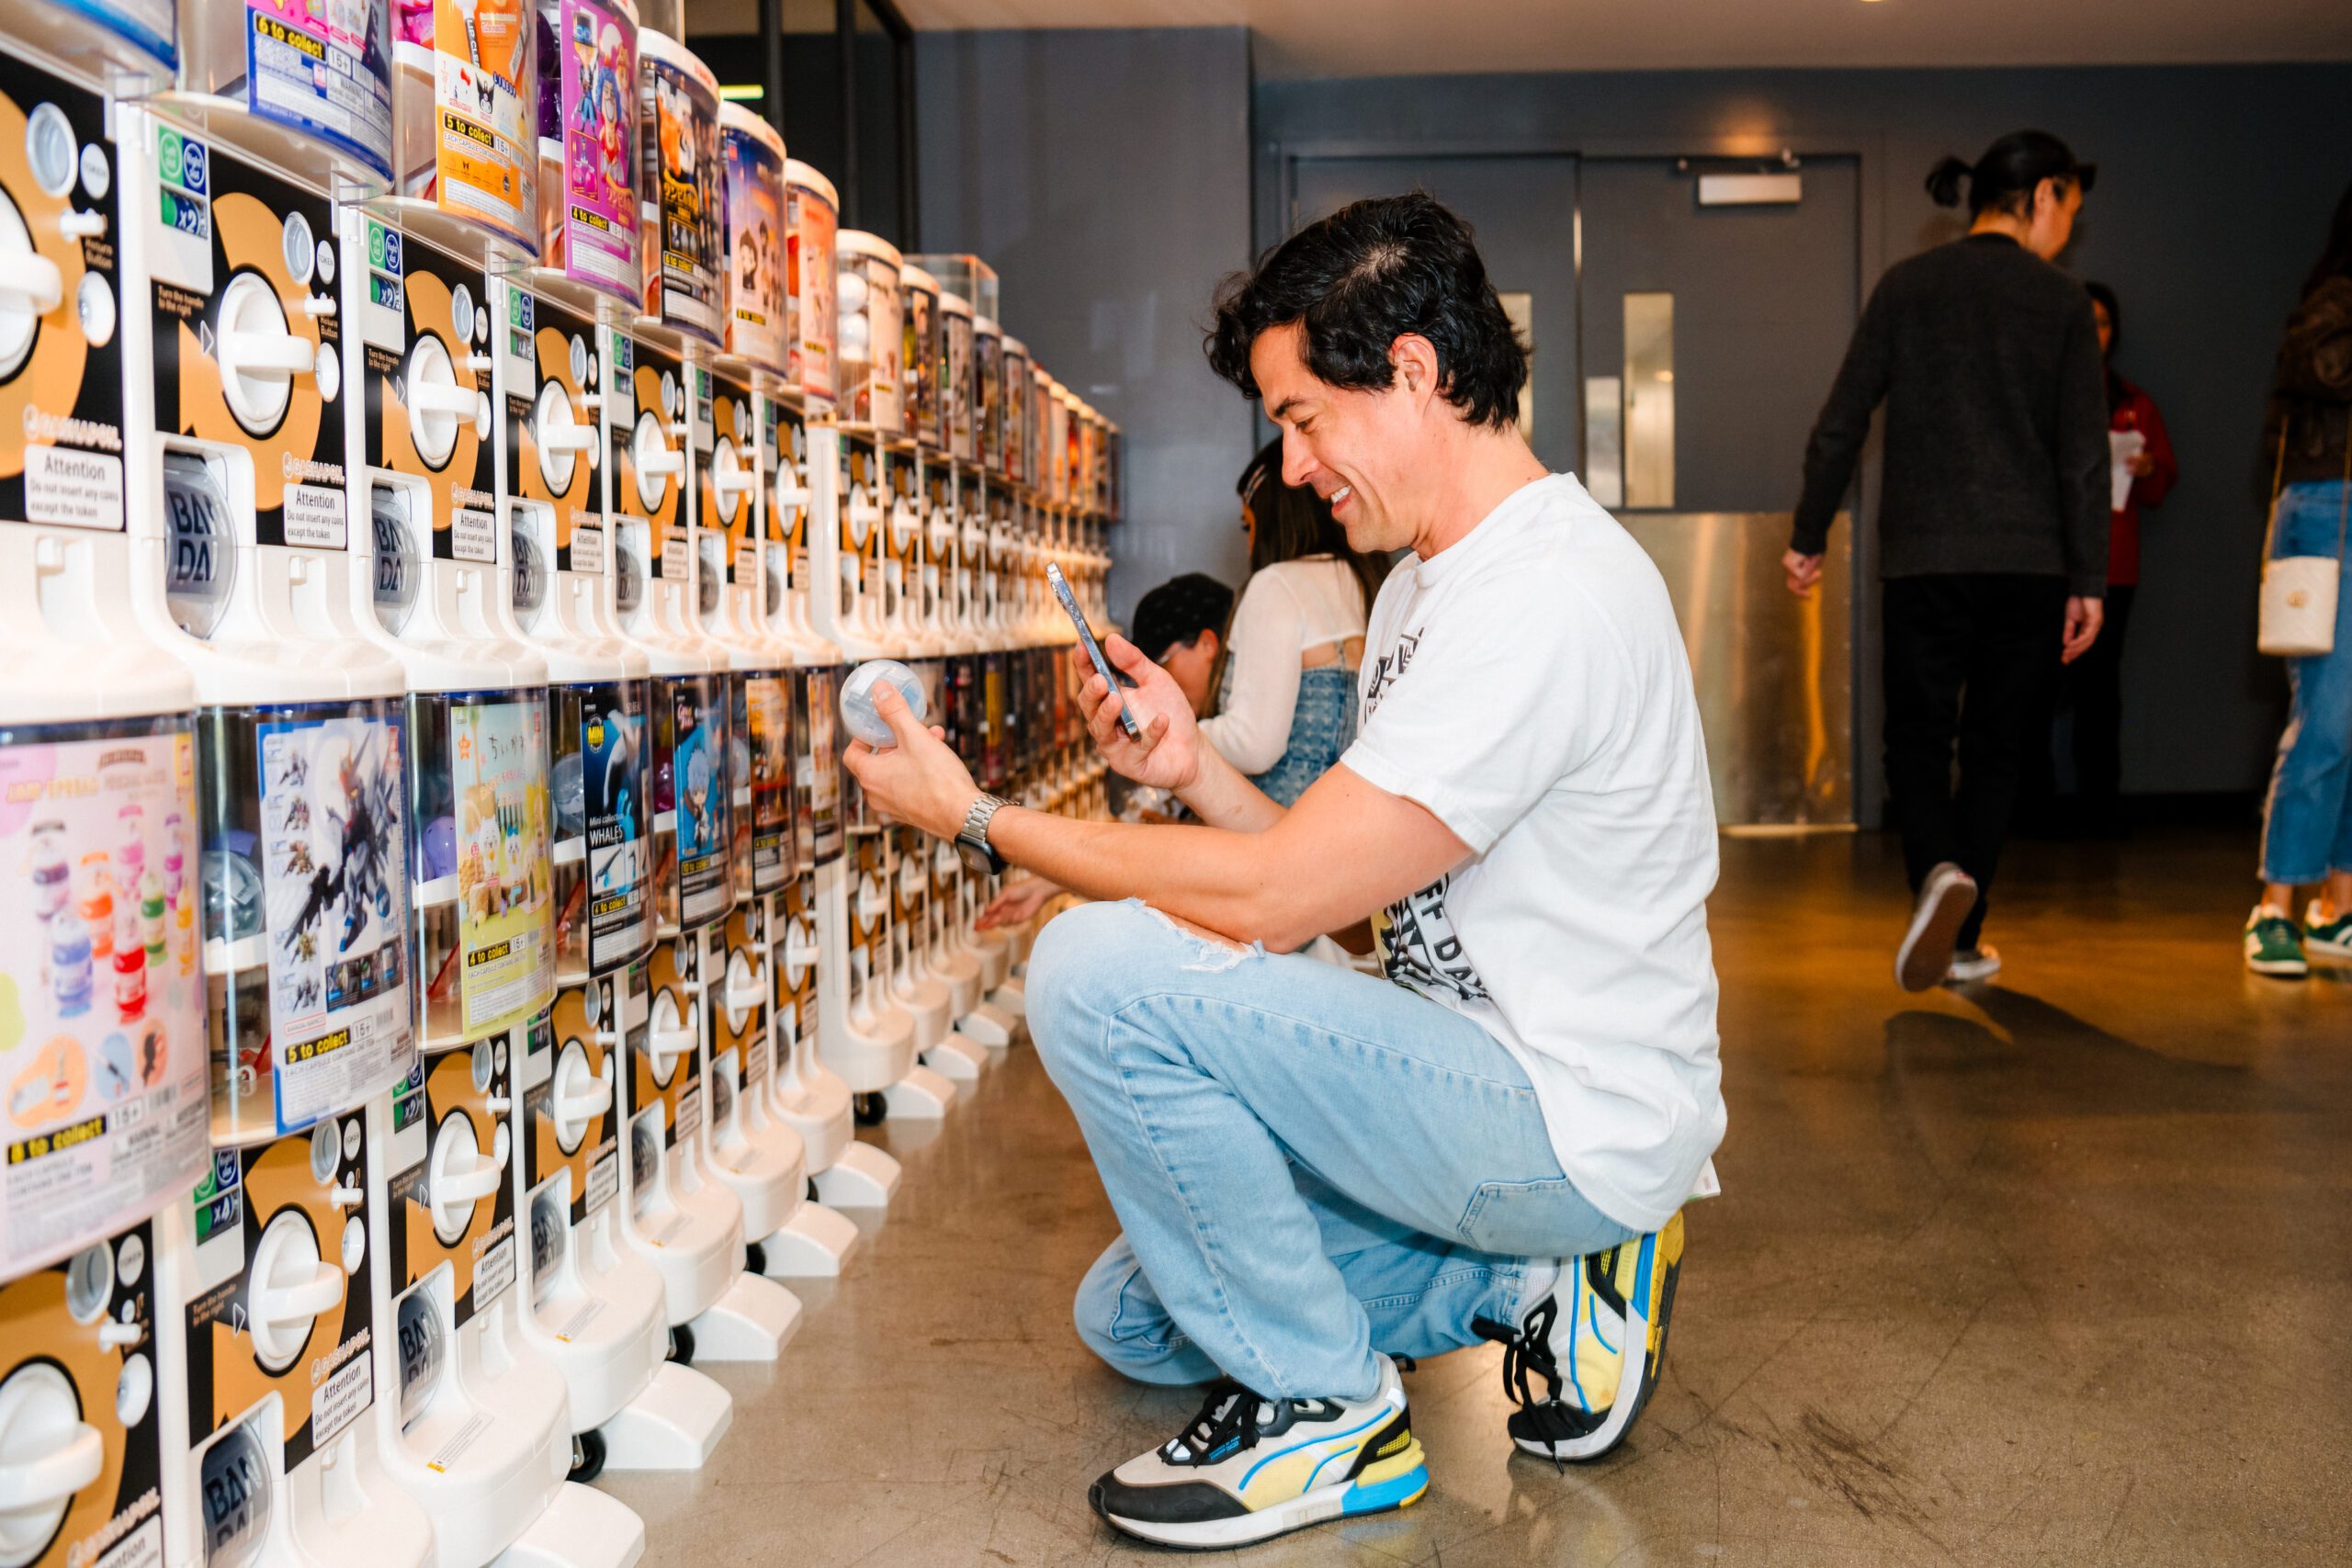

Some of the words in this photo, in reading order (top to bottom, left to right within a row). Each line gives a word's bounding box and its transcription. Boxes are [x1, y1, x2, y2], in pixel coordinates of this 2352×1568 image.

[258, 16, 269, 36] 6
[270, 20, 285, 43] to
[287, 30, 322, 57] collect
[447, 114, 454, 131] 5
[456, 118, 467, 134] to
[468, 126, 492, 146] collect
[321, 326, 338, 338] Button
[44, 453, 106, 481] Attention
[296, 489, 335, 511] Attention
[287, 509, 295, 521] Do
[296, 513, 305, 523] not
[306, 513, 321, 524] insert
[322, 515, 331, 527] any
[332, 516, 344, 526] coins
[460, 513, 488, 530] Attention
[288, 528, 306, 539] except
[306, 527, 315, 538] the
[316, 528, 331, 539] token
[588, 725, 605, 738] MINI
[589, 824, 623, 849] WHALES
[469, 952, 476, 965] 4
[477, 951, 486, 964] to
[487, 943, 508, 960] collect
[355, 1022, 371, 1041] 15+
[288, 1045, 298, 1064] 5
[300, 1043, 314, 1061] to
[316, 1029, 348, 1055] collect
[52, 1117, 104, 1151] collect
[481, 1247, 507, 1276] Attention
[323, 1363, 361, 1404] Attention
[315, 1413, 323, 1426] Do
[323, 1404, 333, 1419] not
[333, 1392, 347, 1412] insert
[347, 1387, 357, 1401] any
[356, 1376, 369, 1392] coins
[315, 1418, 334, 1440] except
[334, 1412, 343, 1427] the
[343, 1400, 357, 1419] token
